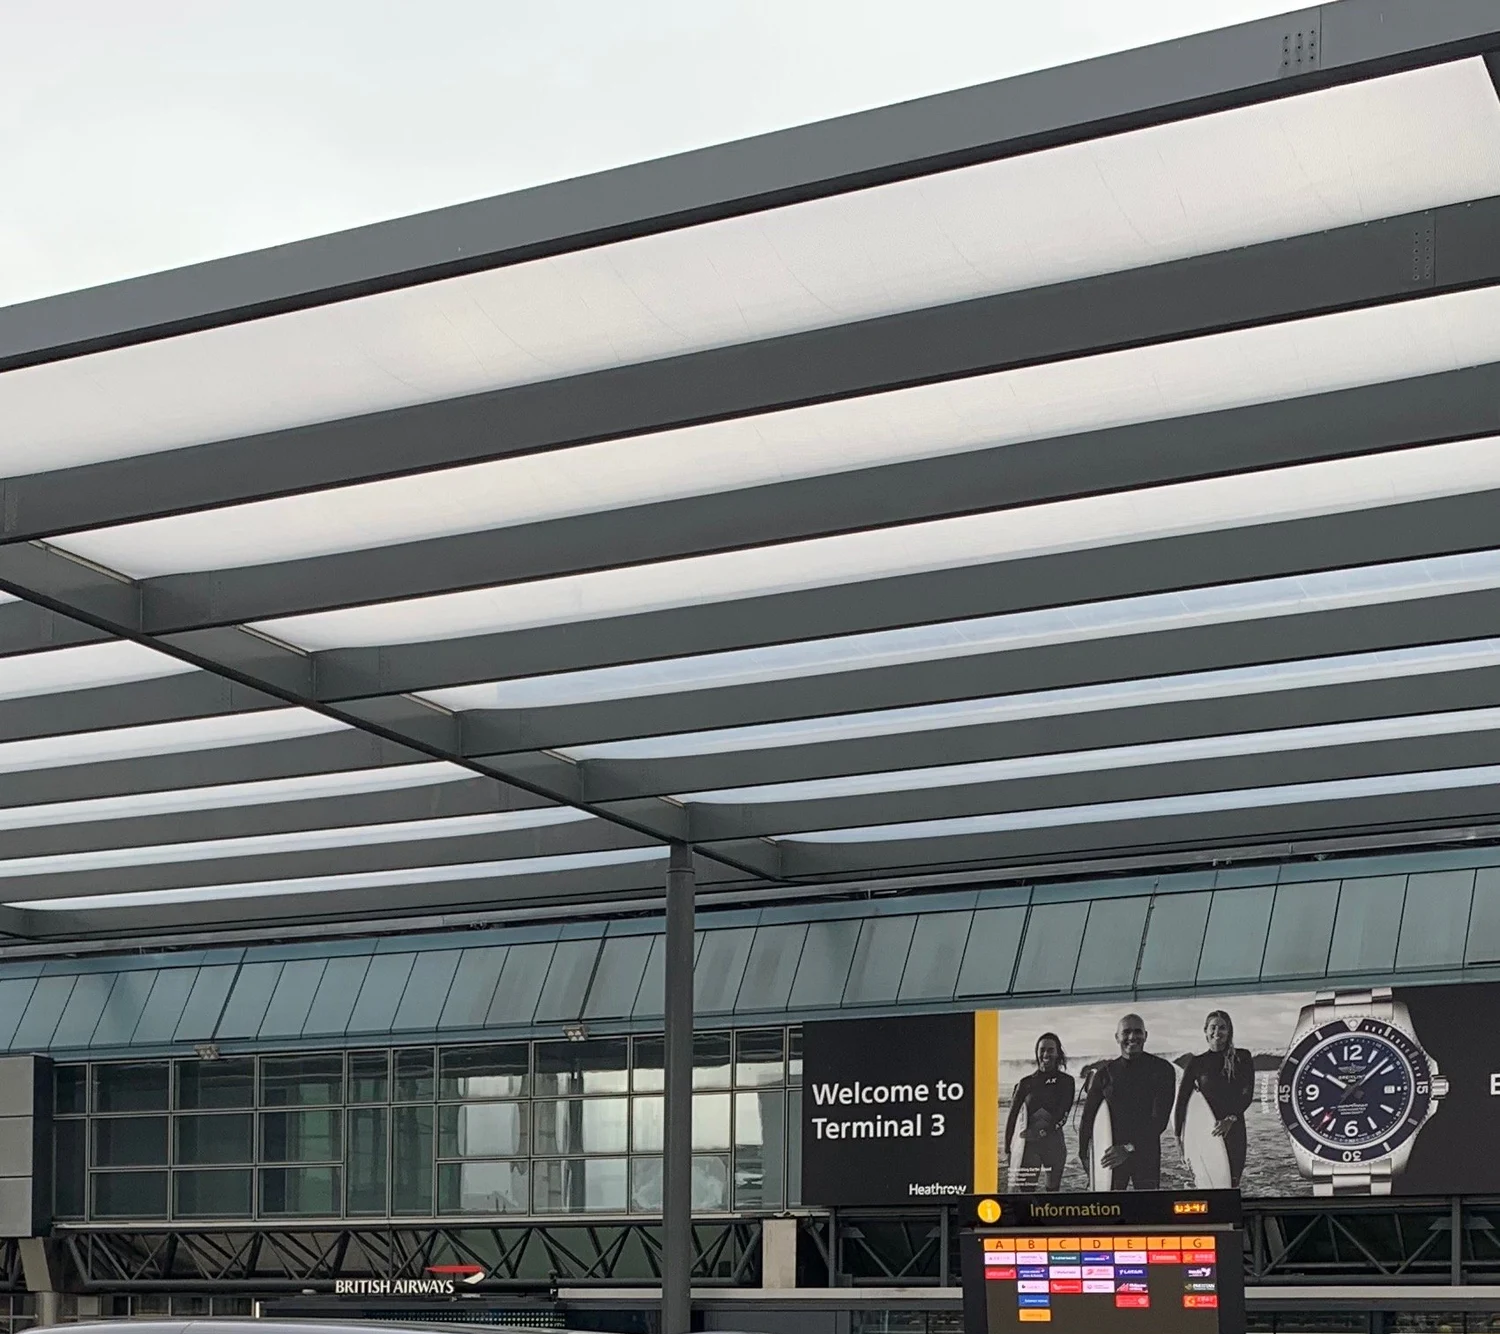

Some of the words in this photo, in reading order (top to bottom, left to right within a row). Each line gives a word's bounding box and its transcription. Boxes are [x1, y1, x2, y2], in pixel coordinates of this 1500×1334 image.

[1343, 1044, 1363, 1061] 12
[812, 1081, 929, 1105] Welcome
[936, 1079, 964, 1101] to
[1279, 1084, 1291, 1103] 45
[1305, 1084, 1319, 1101] 9
[1416, 1080, 1429, 1095] 15
[811, 1113, 922, 1139] Terminal
[930, 1113, 945, 1136] 3
[1344, 1120, 1358, 1138] 6
[1342, 1150, 1362, 1162] 30
[908, 1182, 967, 1196] Heathrow
[1030, 1202, 1121, 1217] Information
[995, 1240, 1004, 1249] A
[1028, 1240, 1035, 1249] B
[1059, 1239, 1067, 1249] C
[1093, 1239, 1101, 1249] D
[1127, 1239, 1133, 1248] E
[1161, 1238, 1166, 1248] F
[1193, 1238, 1202, 1248] G
[335, 1279, 391, 1294] BRITISH
[393, 1280, 454, 1294] AIRWAYS
